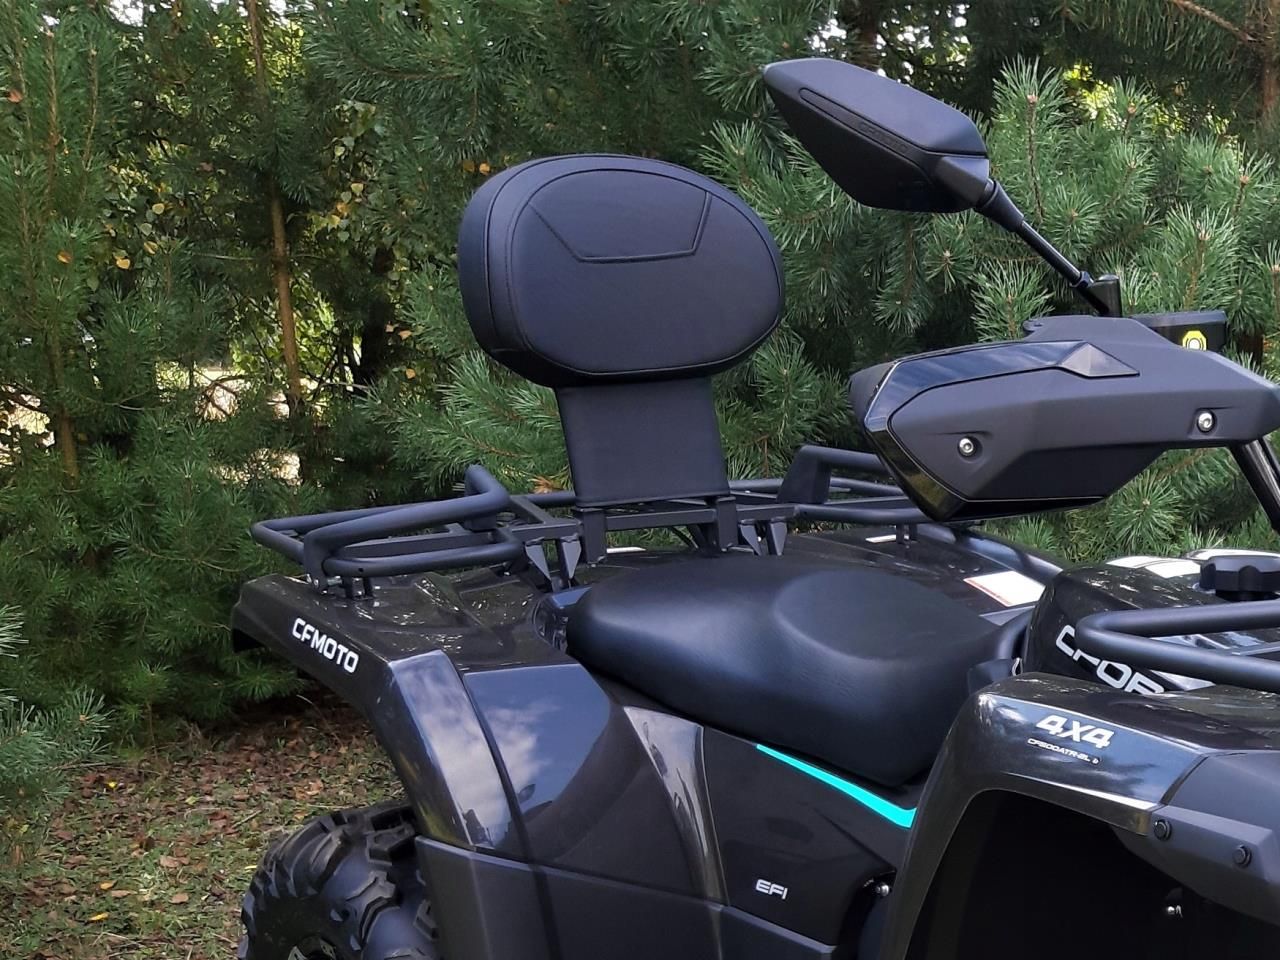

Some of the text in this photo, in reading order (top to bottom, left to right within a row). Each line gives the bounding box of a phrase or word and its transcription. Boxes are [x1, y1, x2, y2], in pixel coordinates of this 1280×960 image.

[292, 617, 359, 674] CFMOTO
[1035, 714, 1115, 749] 4X4
[755, 879, 788, 900] EFI
